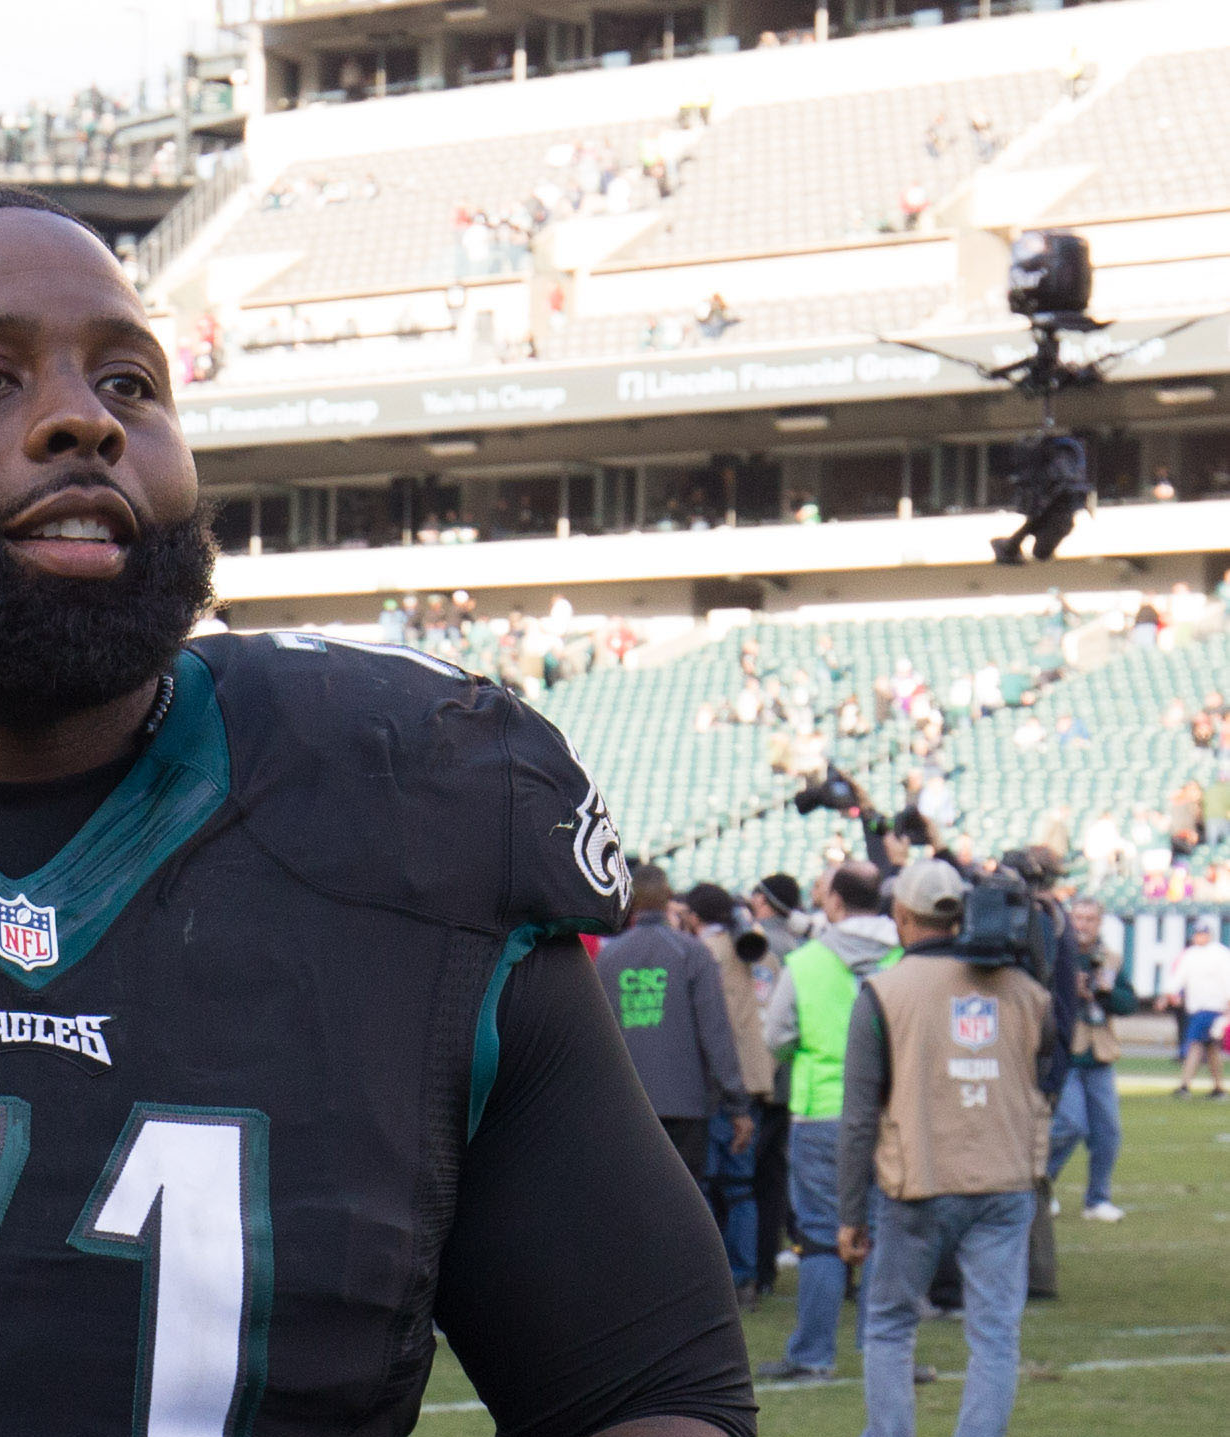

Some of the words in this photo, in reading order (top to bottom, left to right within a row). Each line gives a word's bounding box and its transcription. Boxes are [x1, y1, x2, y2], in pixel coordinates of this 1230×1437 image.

[856, 352, 941, 384] Group
[308, 398, 379, 427] Group
[4, 925, 48, 958] NFL
[618, 967, 669, 992] CSC
